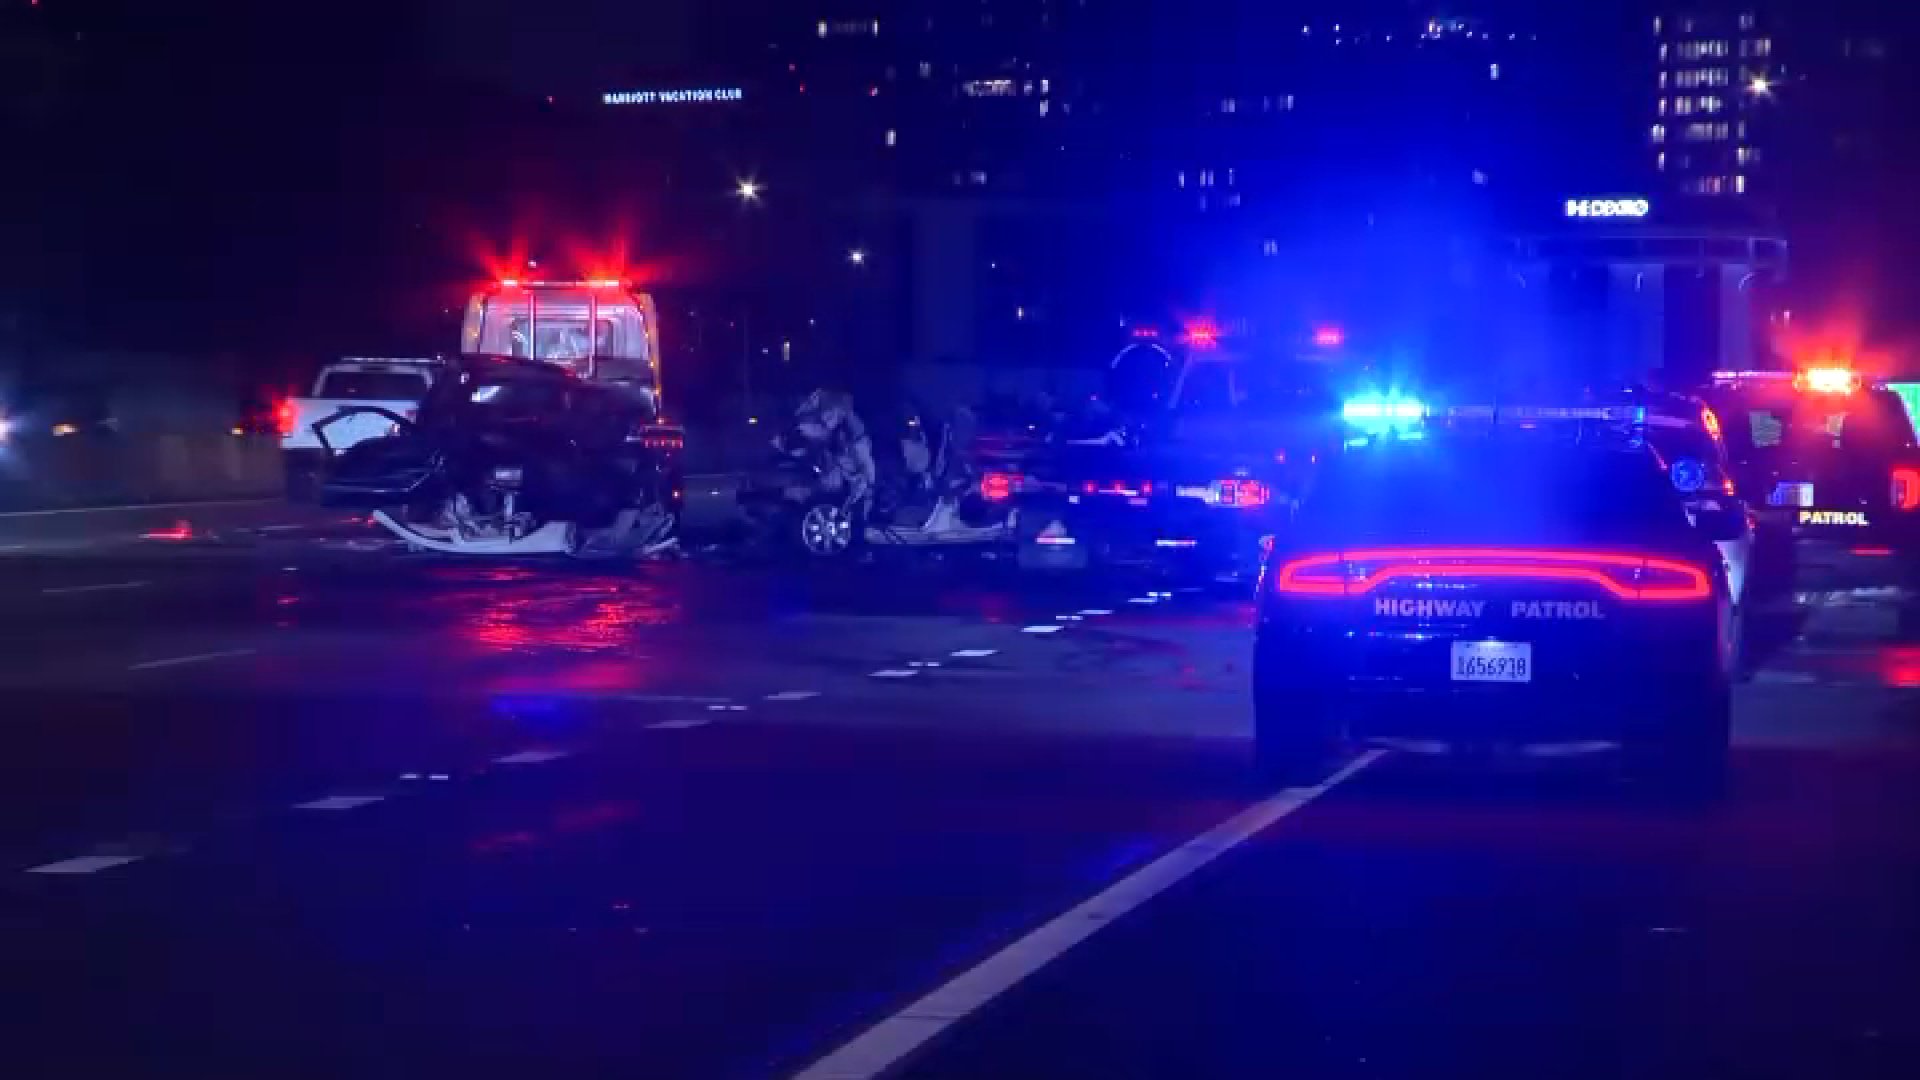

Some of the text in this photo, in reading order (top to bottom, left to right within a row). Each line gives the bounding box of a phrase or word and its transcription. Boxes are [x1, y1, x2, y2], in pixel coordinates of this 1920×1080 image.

[1799, 511, 1869, 526] PATROL
[1374, 597, 1605, 619] HIGHWAY PATROL
